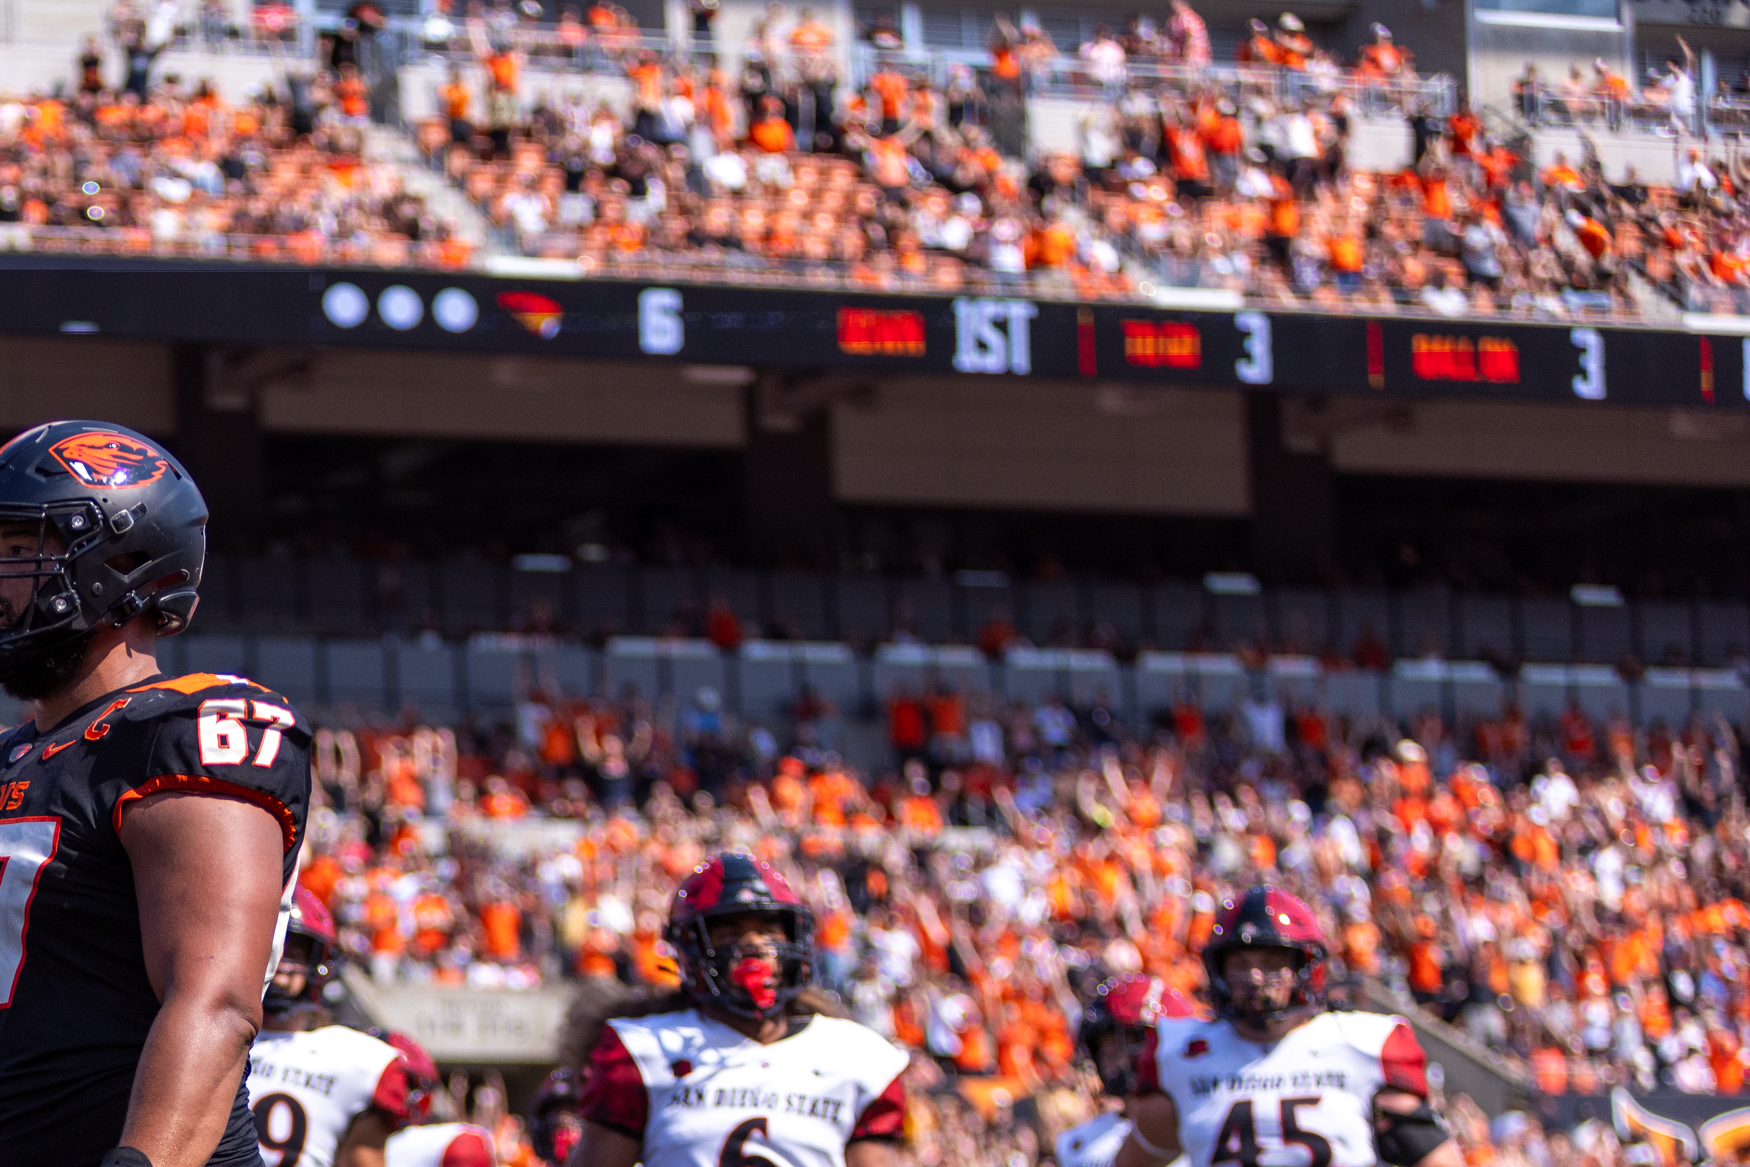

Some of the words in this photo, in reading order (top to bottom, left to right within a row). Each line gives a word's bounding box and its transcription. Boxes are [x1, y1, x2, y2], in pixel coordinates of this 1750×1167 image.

[638, 286, 684, 355] 6
[1234, 310, 1274, 384] 3
[1570, 326, 1607, 400] 3
[198, 698, 295, 767] 67
[714, 1087, 778, 1109] DIEGO
[785, 1093, 844, 1122] STATE
